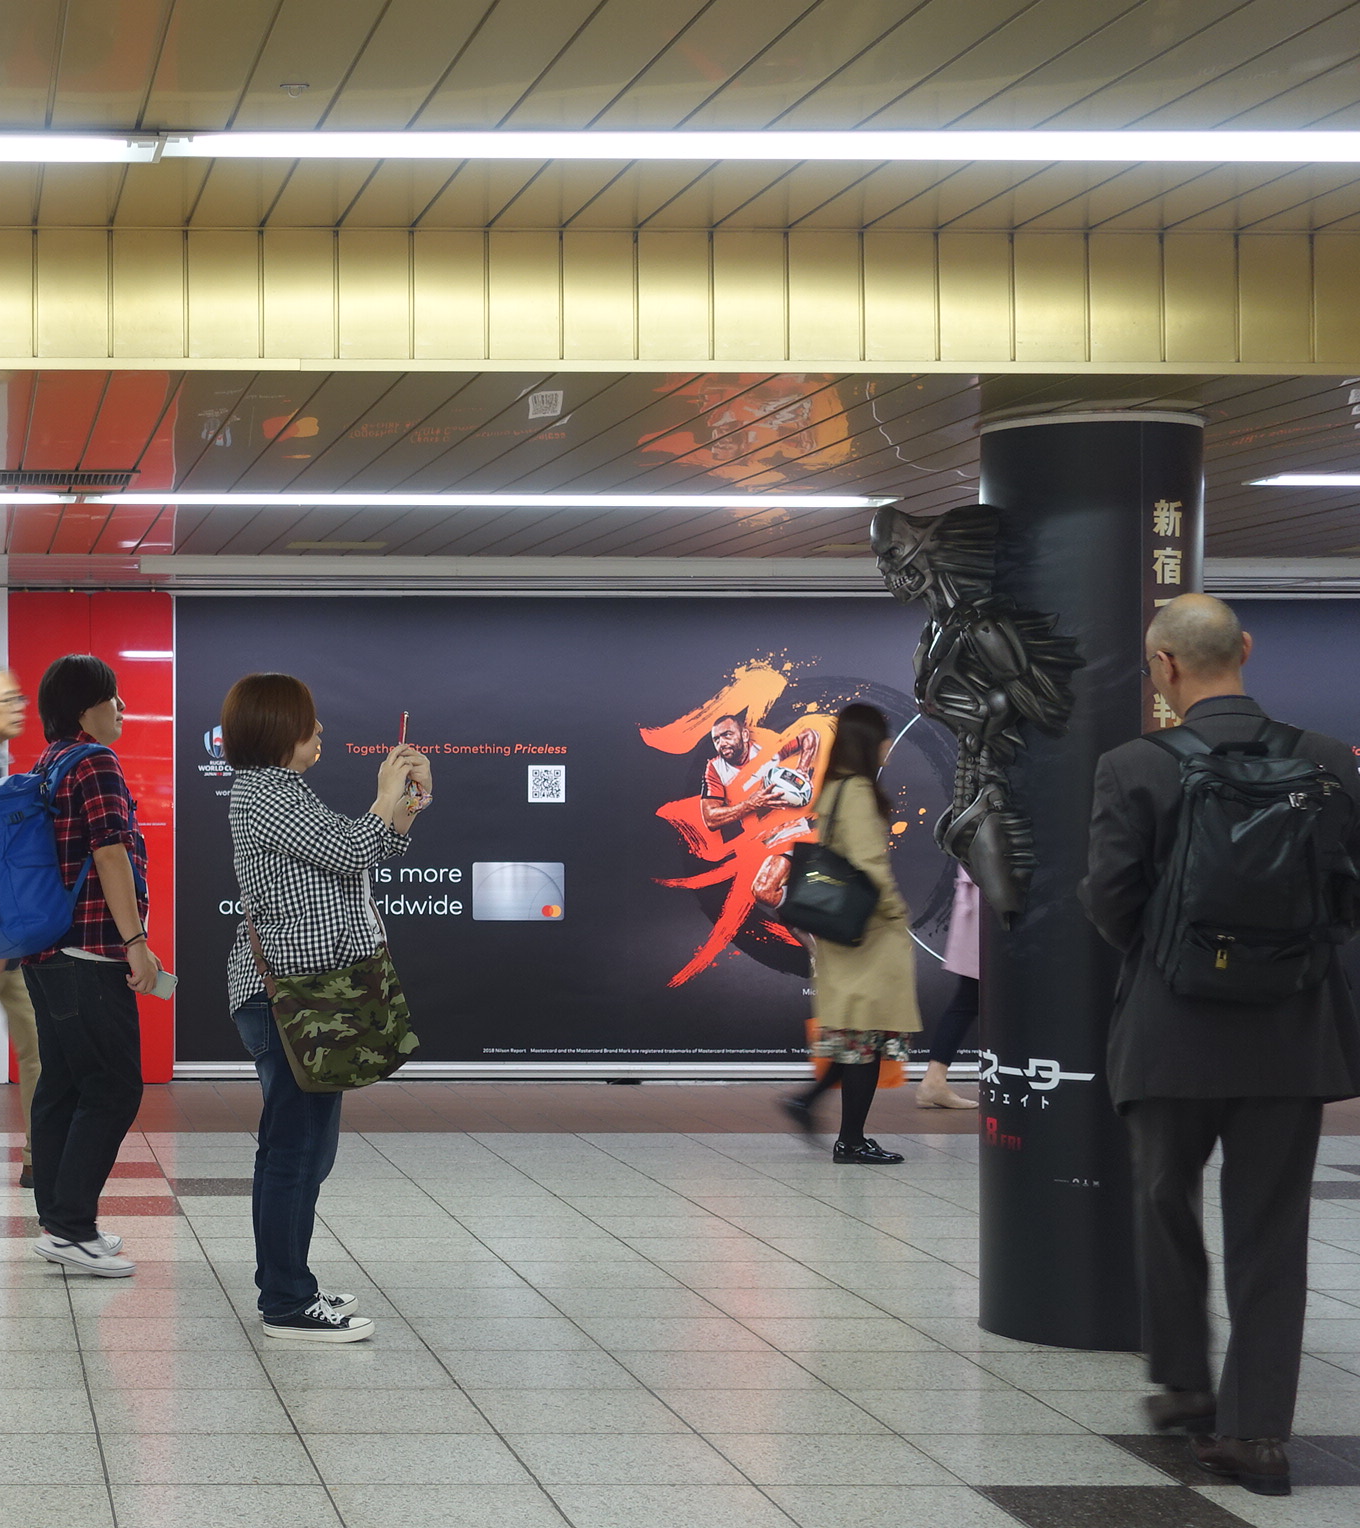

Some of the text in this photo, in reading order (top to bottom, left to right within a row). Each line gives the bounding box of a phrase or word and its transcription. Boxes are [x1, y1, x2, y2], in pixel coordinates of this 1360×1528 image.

[346, 743, 394, 757] Togethe
[443, 743, 511, 757] Something
[514, 743, 568, 755] Priceless
[400, 867, 463, 883] more
[375, 895, 463, 915] rldwide
[510, 1047, 527, 1055] Report
[978, 1049, 1096, 1091] ネーター
